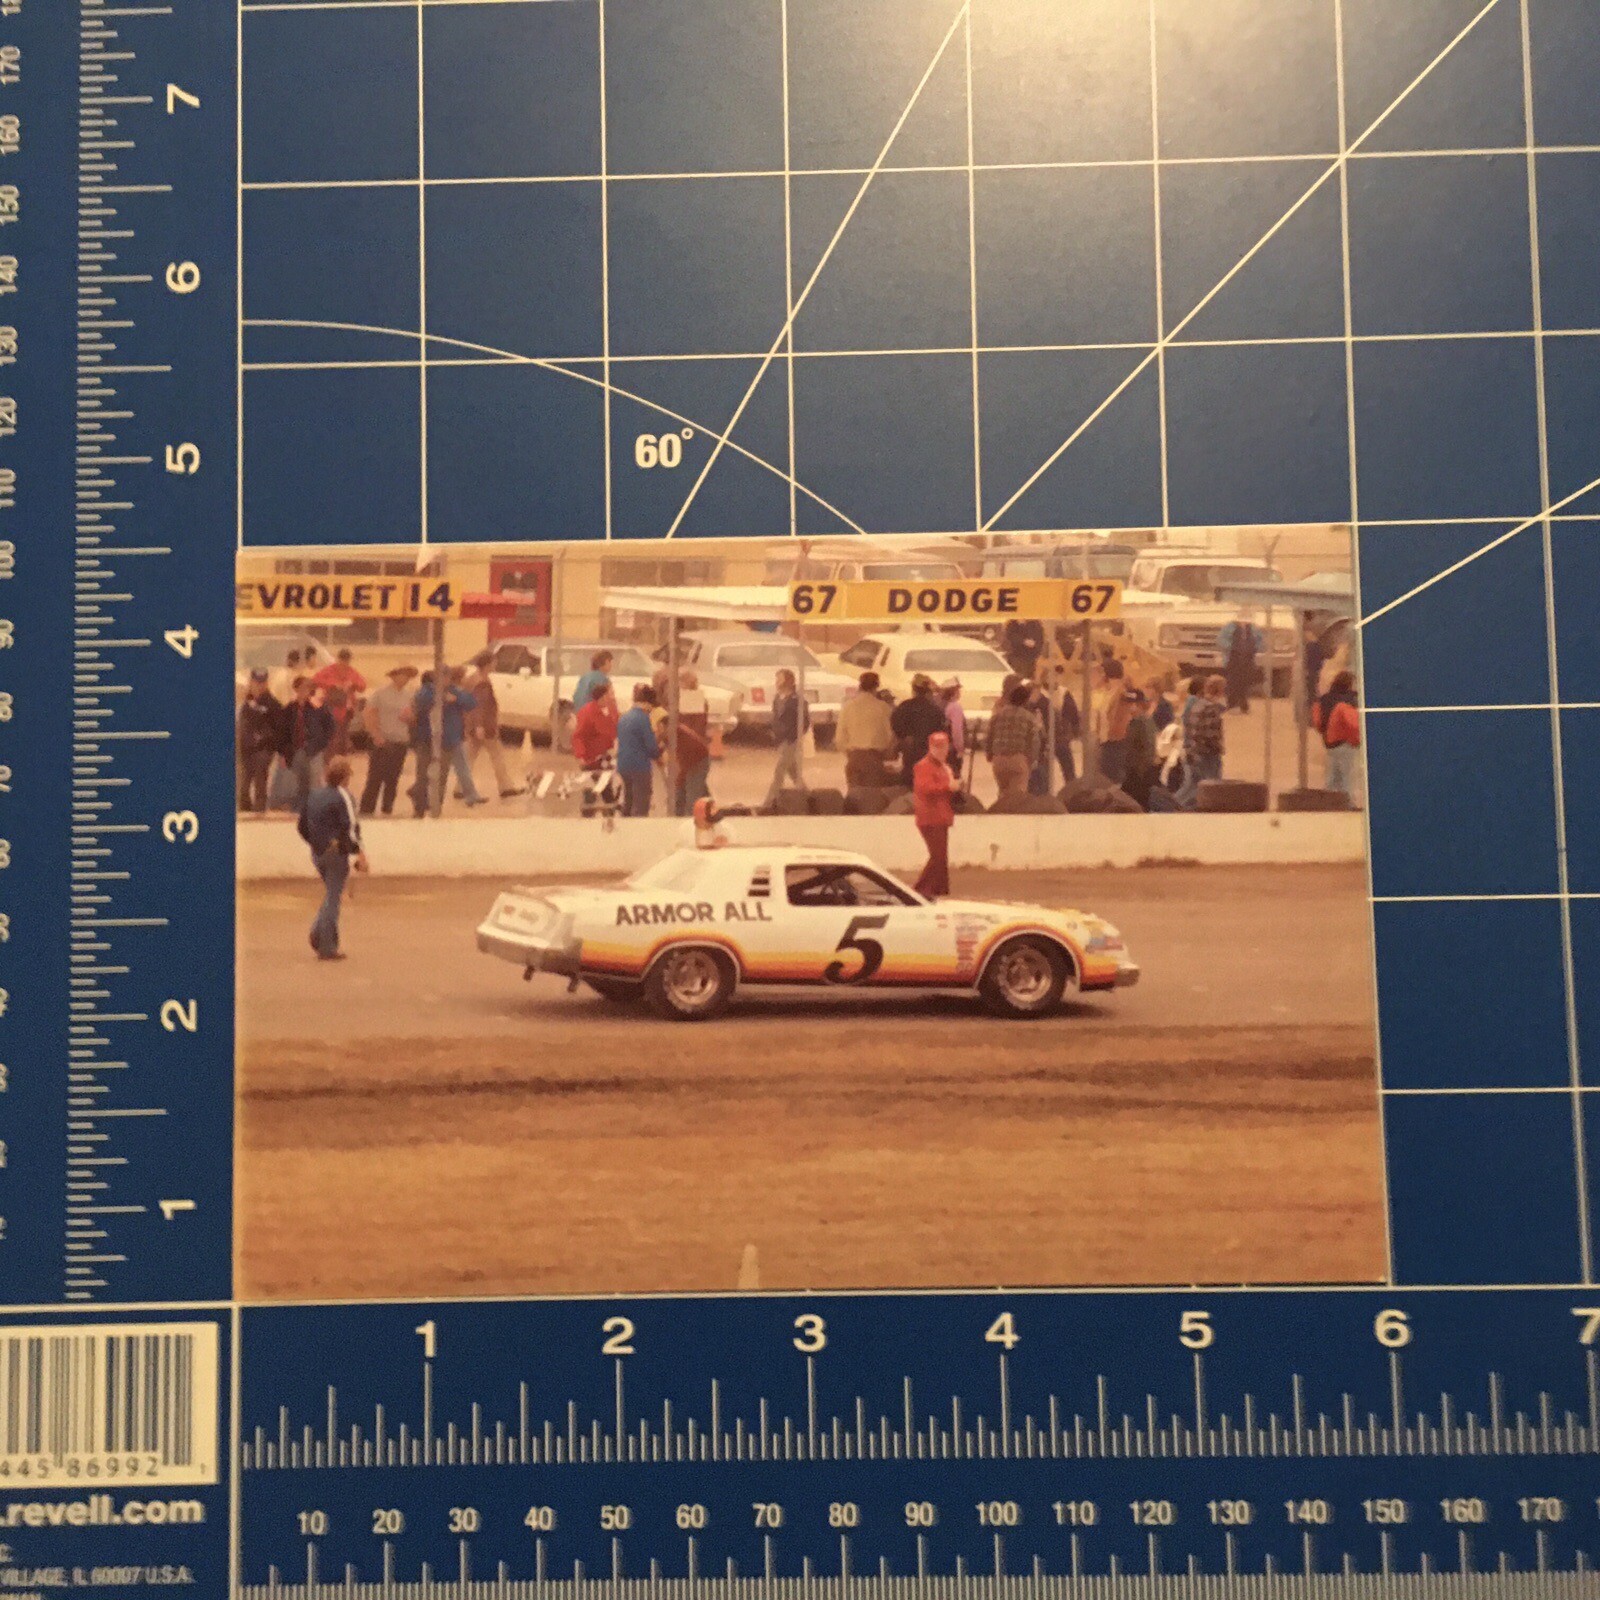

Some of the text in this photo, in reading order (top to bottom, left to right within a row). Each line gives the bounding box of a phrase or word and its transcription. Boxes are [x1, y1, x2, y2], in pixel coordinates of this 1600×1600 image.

[0, 45, 21, 86] 170
[166, 83, 200, 114] 7
[0, 114, 20, 155] 160
[0, 184, 20, 226] 150
[0, 255, 19, 296] 140
[165, 261, 201, 294] 6
[0, 325, 18, 367] 130
[0, 397, 17, 438] 120
[165, 442, 201, 475] 5
[410, 582, 455, 612] 14
[792, 584, 1116, 614] 67 DODGE 67
[163, 624, 200, 659] 4
[162, 809, 199, 843] 3
[615, 901, 773, 926] ARMOR ALL
[822, 913, 890, 985] 5
[160, 998, 197, 1032] 2
[158, 1199, 196, 1220] 1
[415, 1320, 436, 1358] 1
[602, 1316, 635, 1355] 2
[793, 1313, 827, 1353] 3
[984, 1312, 1020, 1350] 4
[1179, 1310, 1213, 1350] 5
[1374, 1308, 1411, 1348] 6
[1571, 1307, 1600, 1345] 7
[66, 1456, 158, 1478] 86992
[298, 1509, 328, 1535] 10
[373, 1508, 404, 1533] 20
[448, 1506, 479, 1533] 30
[524, 1505, 555, 1531] 40
[601, 1505, 631, 1530] 50
[676, 1503, 707, 1530] 60
[752, 1502, 783, 1528] 70
[828, 1502, 859, 1527] 80
[904, 1501, 935, 1527] 90
[976, 1501, 1019, 1526] 100
[1053, 1501, 1096, 1526] 110
[1129, 1500, 1173, 1526] 120
[1207, 1500, 1251, 1525] 130
[1285, 1499, 1329, 1525] 140
[1362, 1499, 1407, 1524] 150
[1440, 1498, 1486, 1523] 160
[1518, 1497, 1563, 1523] 170
